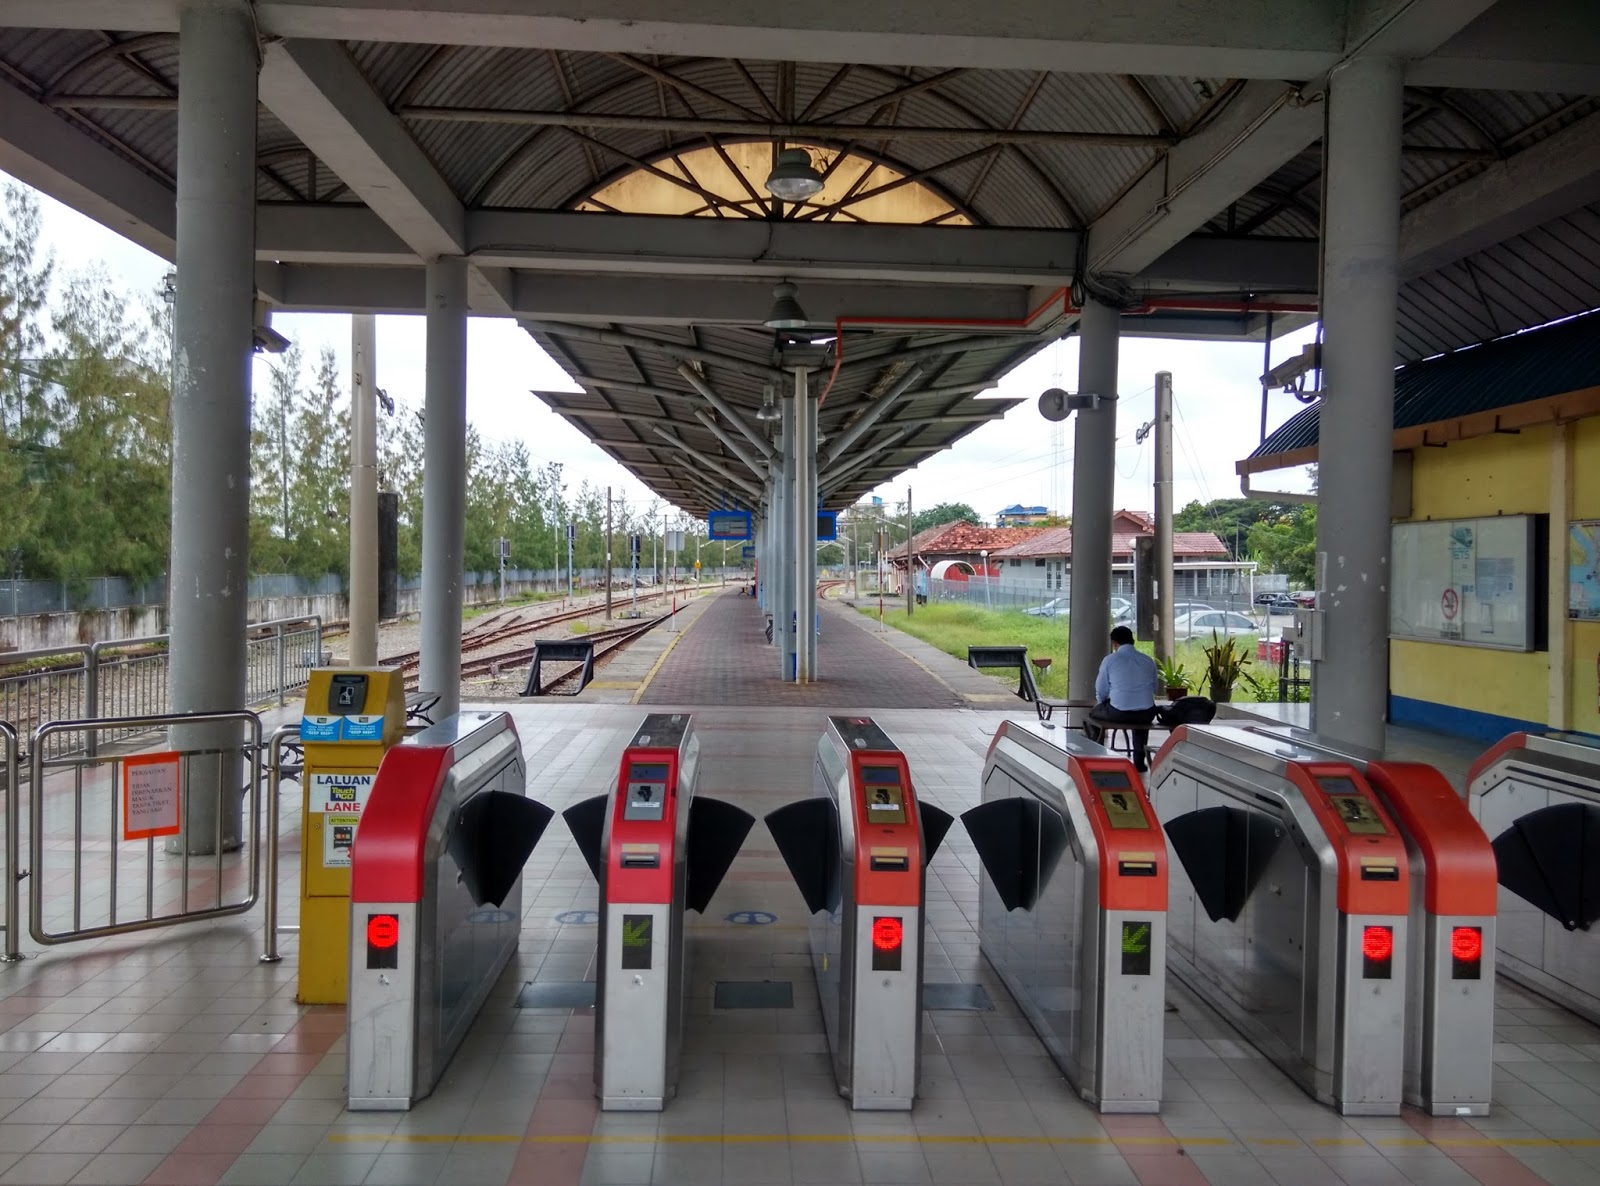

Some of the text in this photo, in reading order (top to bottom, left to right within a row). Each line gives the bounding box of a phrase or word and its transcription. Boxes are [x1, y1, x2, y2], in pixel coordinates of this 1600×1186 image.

[317, 775, 371, 785] LALUAN
[132, 787, 172, 795] DIBENARKAN
[331, 786, 355, 794] Touch
[325, 802, 361, 812] LANE
